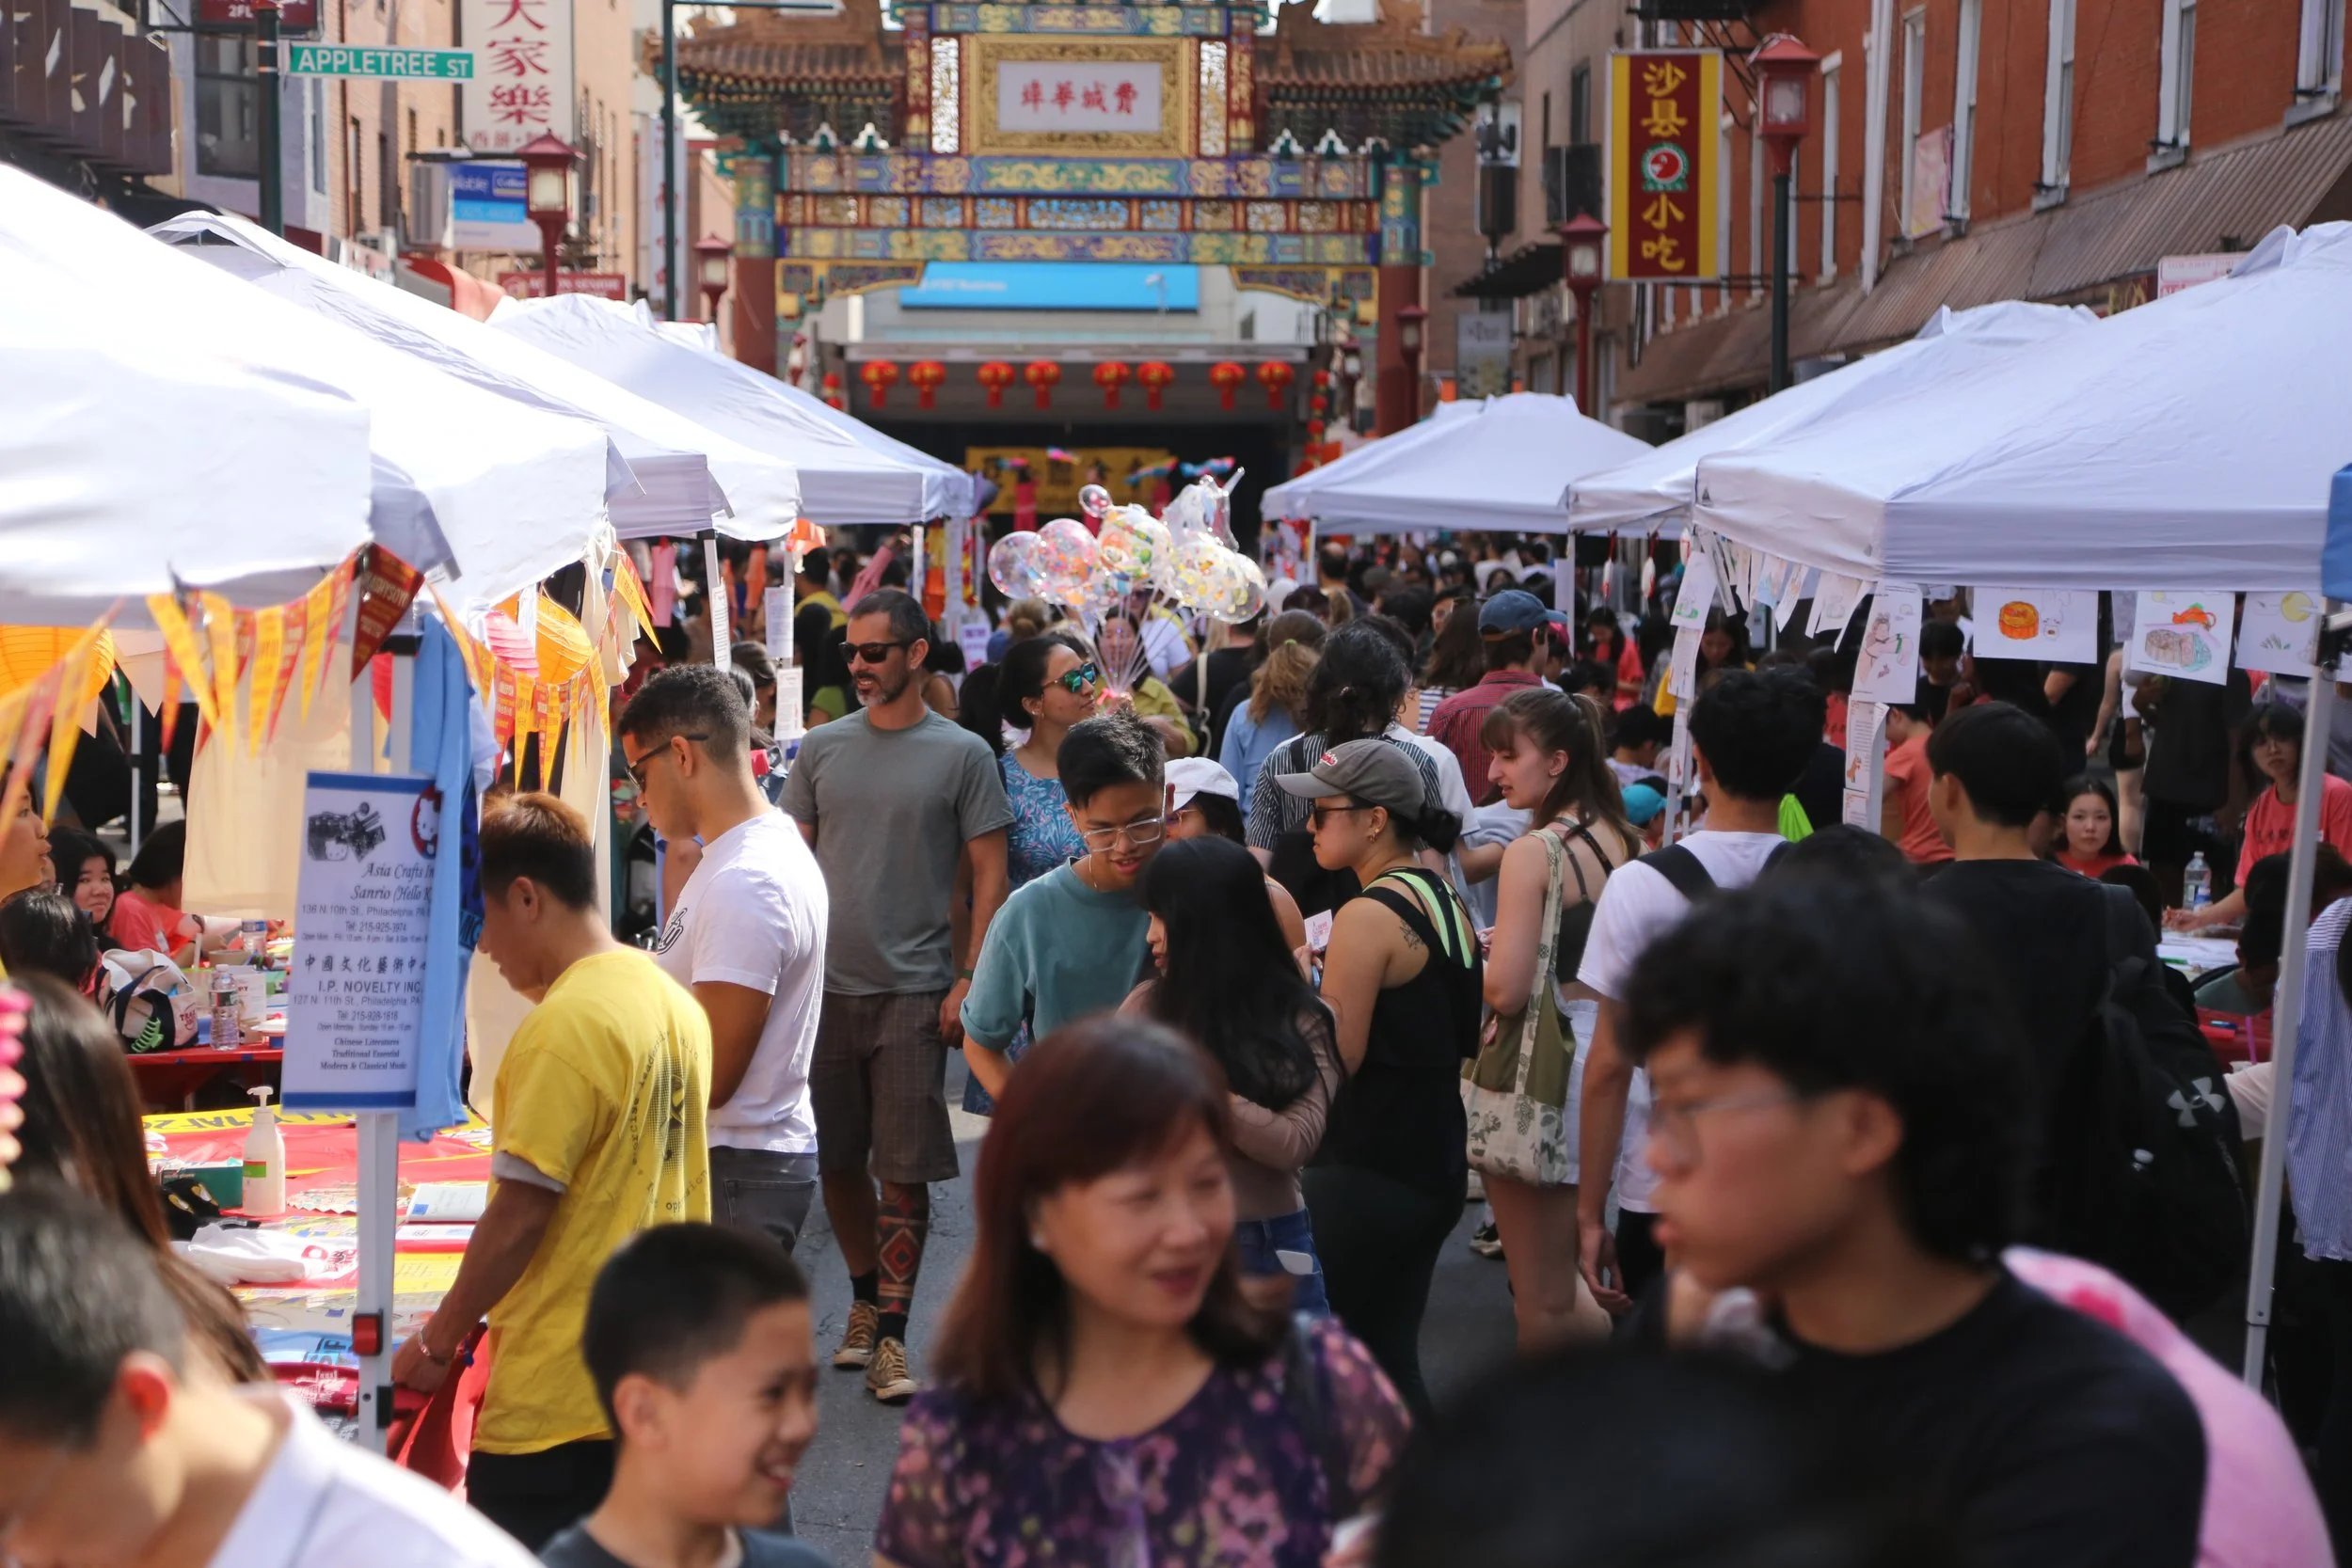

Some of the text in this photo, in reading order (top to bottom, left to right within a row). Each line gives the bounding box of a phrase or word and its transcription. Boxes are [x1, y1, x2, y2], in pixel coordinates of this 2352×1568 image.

[297, 49, 469, 77] APPLETREE ST
[1640, 59, 1689, 272] 沙县小吃
[361, 862, 391, 879] Asia
[393, 863, 423, 882] Crafts
[350, 884, 390, 901] Sanrio
[392, 885, 422, 903] (Hello
[343, 981, 401, 993] NOVELTY
[334, 1037, 363, 1046] Chinese
[332, 1050, 371, 1058] Traditional
[320, 1062, 348, 1070] Modern
[358, 1062, 388, 1070] Classical
[389, 1062, 407, 1070] Music
